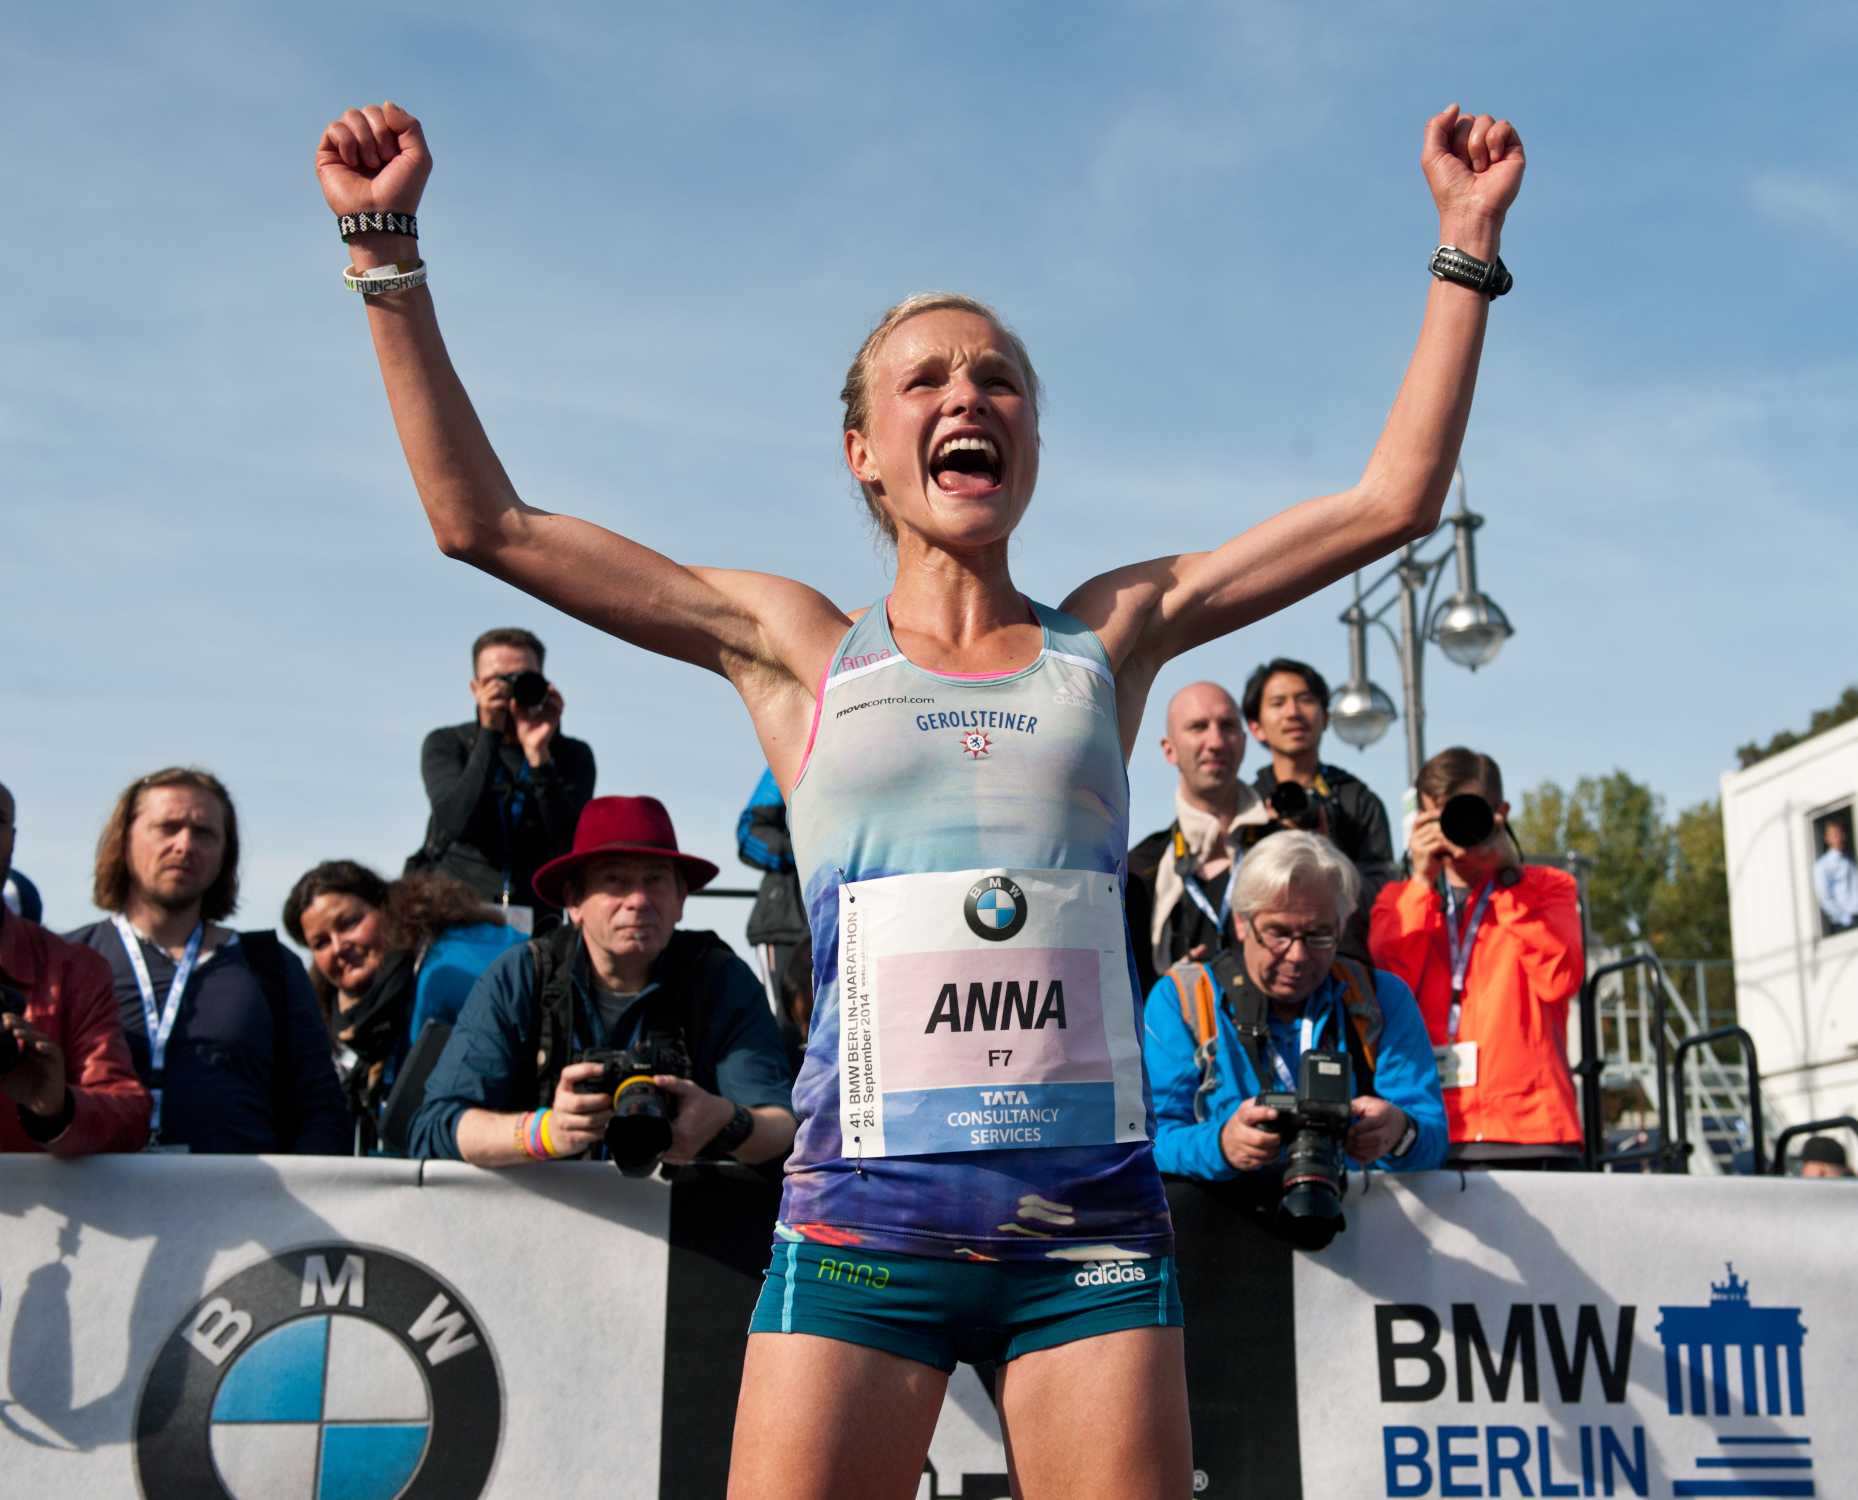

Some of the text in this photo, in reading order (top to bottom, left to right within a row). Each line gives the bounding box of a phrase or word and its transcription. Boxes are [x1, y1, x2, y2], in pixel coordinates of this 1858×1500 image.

[836, 695, 936, 719] movecontrol.com
[916, 710, 1038, 735] GEROLSTEINER
[969, 877, 1022, 899] BMW
[860, 993, 871, 1026] 2014
[924, 980, 1067, 1034] ANNA
[846, 911, 861, 1128] 41. BMW BERLIN-MARATHON
[861, 1029, 876, 1103] September
[988, 1049, 1013, 1067] F7
[980, 1090, 1030, 1106] TATA
[863, 1106, 874, 1128] 28.
[947, 1107, 1060, 1127] CONSULTANCY
[970, 1127, 1042, 1145] SERVICES
[1074, 1265, 1146, 1287] adidas
[181, 1252, 482, 1368] BMW
[1374, 1302, 1637, 1404] BMW
[1382, 1424, 1649, 1499] BERLIN
